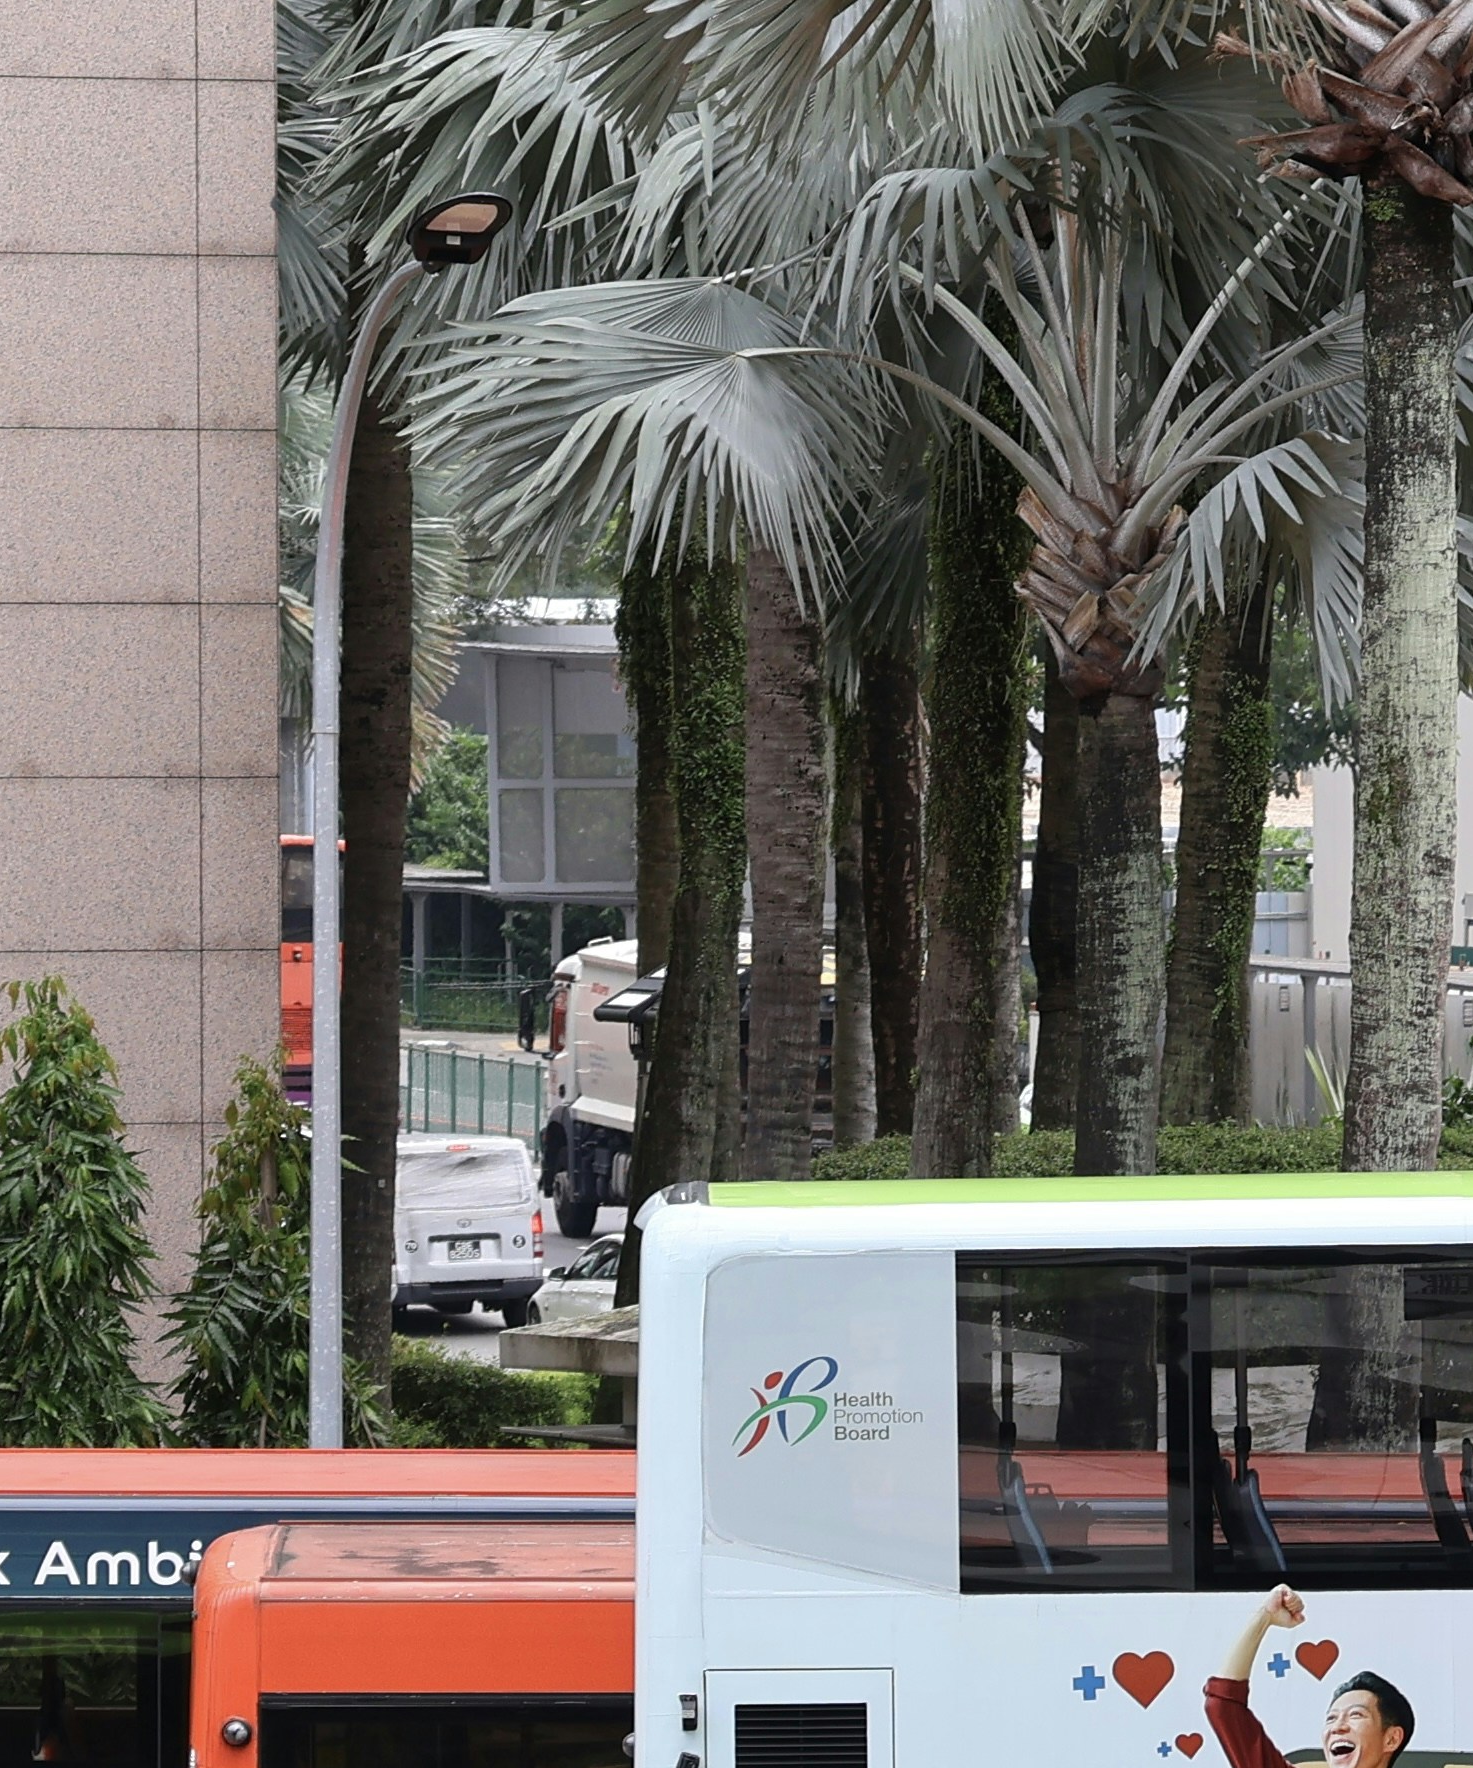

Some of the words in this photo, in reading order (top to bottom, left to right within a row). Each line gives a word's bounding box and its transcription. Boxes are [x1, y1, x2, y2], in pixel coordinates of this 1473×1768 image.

[833, 1391, 893, 1407] Health
[833, 1408, 924, 1424] Promotion
[834, 1425, 890, 1441] Board
